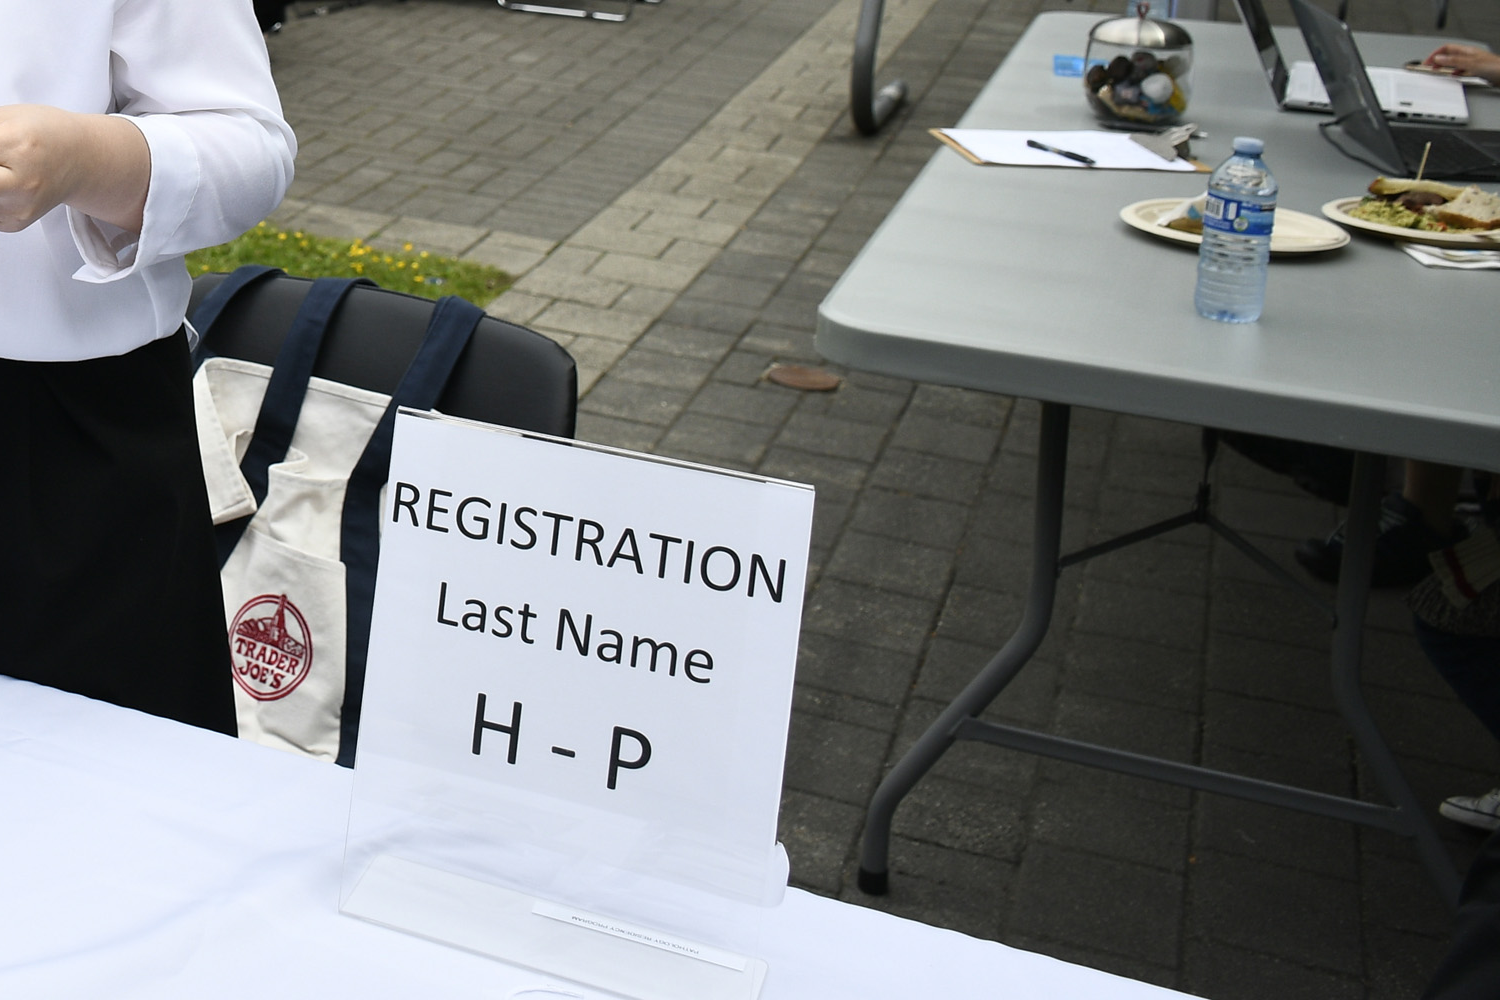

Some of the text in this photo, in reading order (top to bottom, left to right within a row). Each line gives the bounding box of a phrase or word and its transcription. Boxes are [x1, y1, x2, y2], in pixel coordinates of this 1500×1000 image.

[391, 481, 788, 603] REGISTRATION
[235, 637, 299, 675] TRADER
[238, 660, 286, 690] JOE'S
[436, 581, 714, 684] Last Name
[471, 693, 653, 790] H - P
